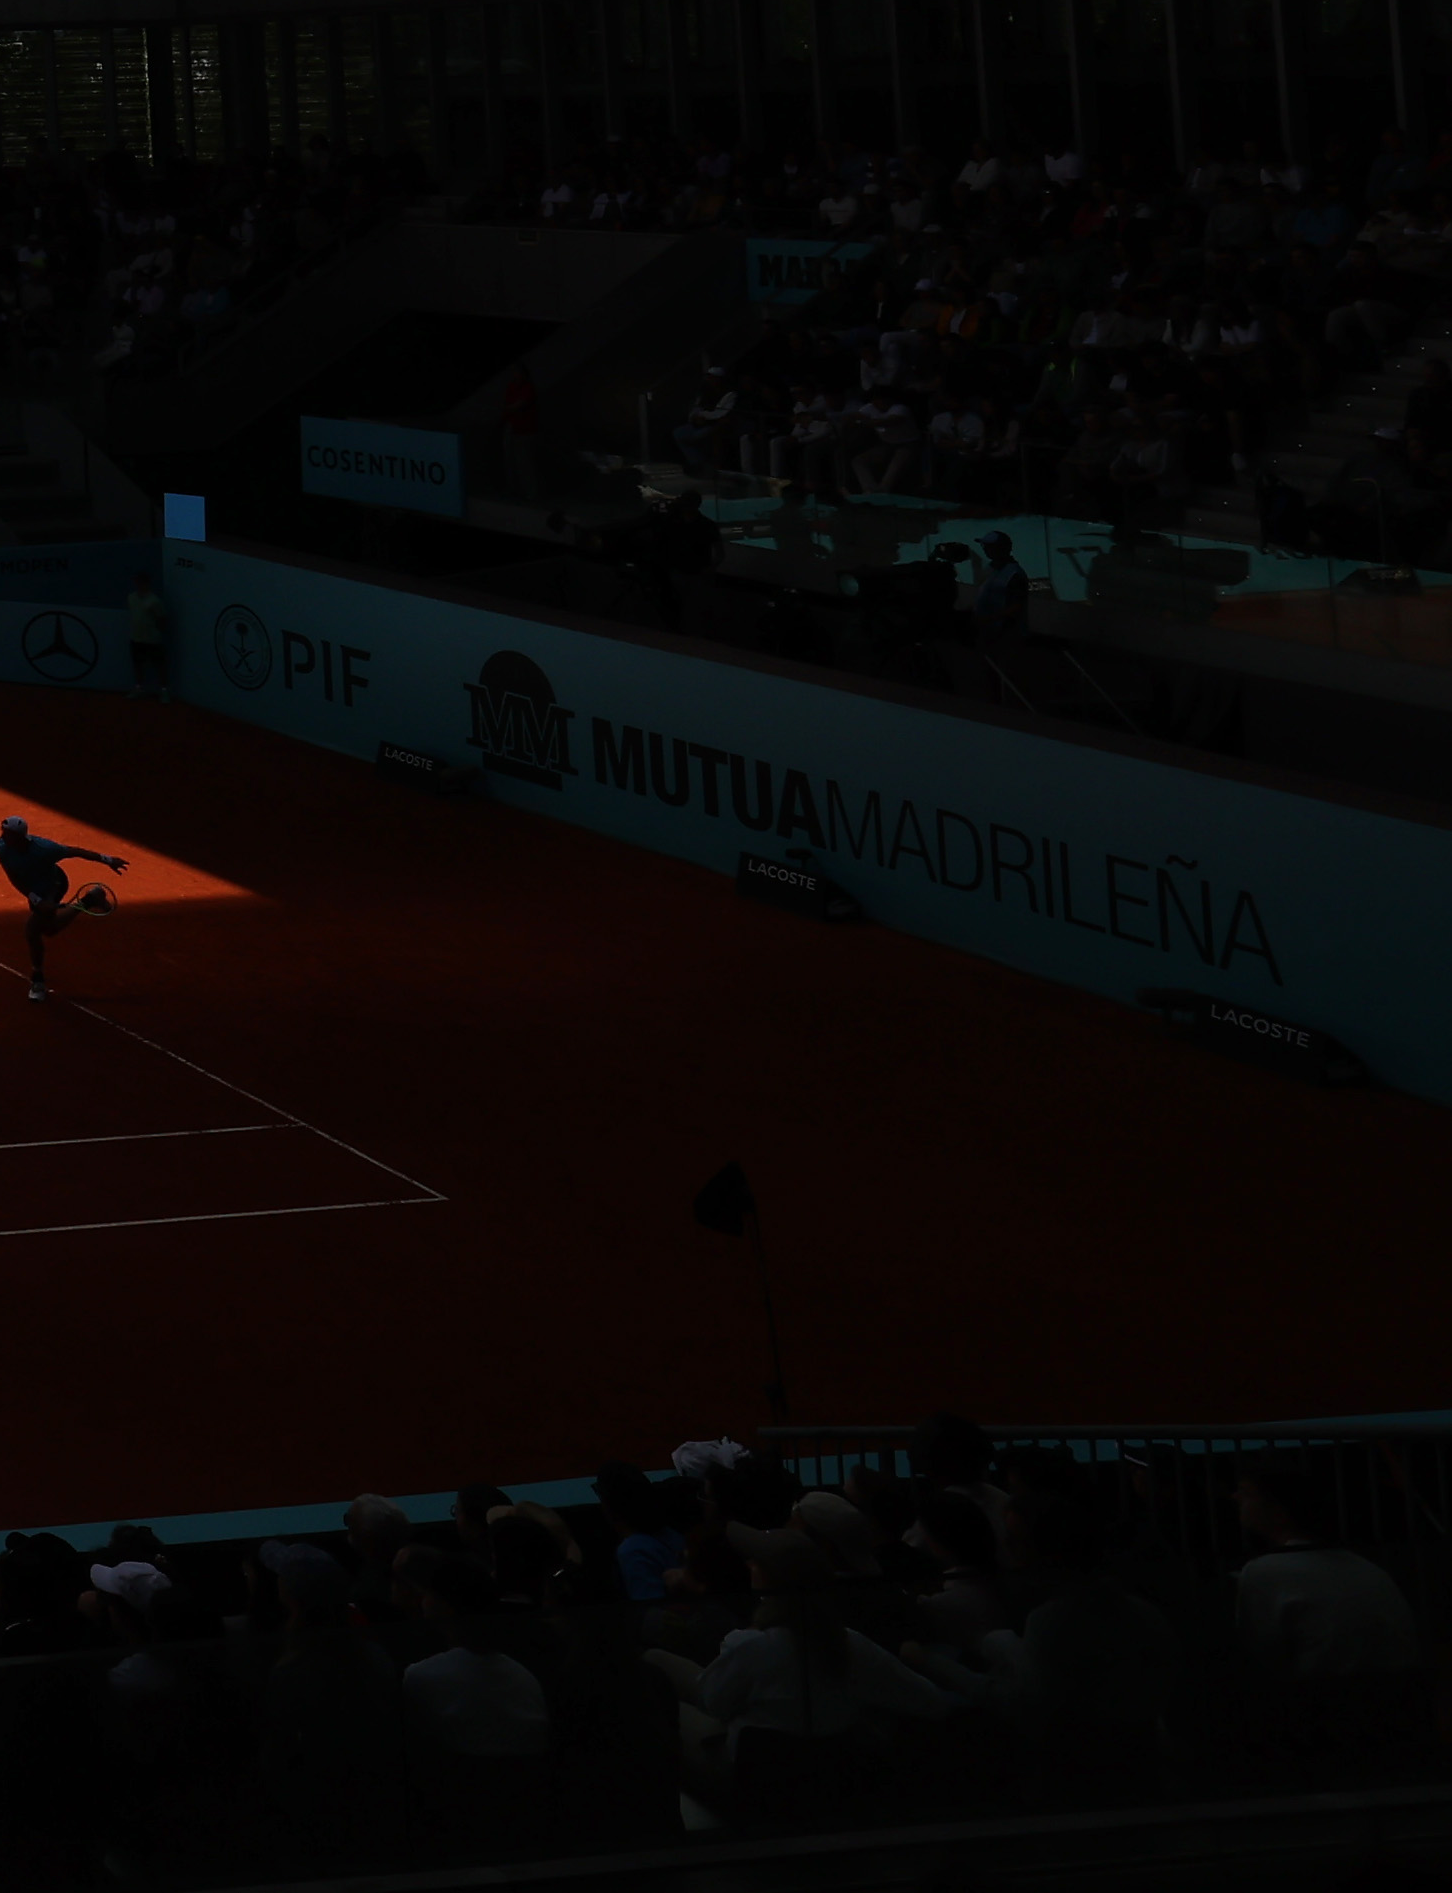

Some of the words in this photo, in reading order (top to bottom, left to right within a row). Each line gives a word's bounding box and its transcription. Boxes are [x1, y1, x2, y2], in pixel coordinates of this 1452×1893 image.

[307, 445, 446, 486] COSENTINO
[281, 629, 371, 707] PIF
[384, 746, 434, 772] LACOSTE
[747, 858, 817, 894] LACOSTE
[1210, 1003, 1311, 1049] LACOSTE
